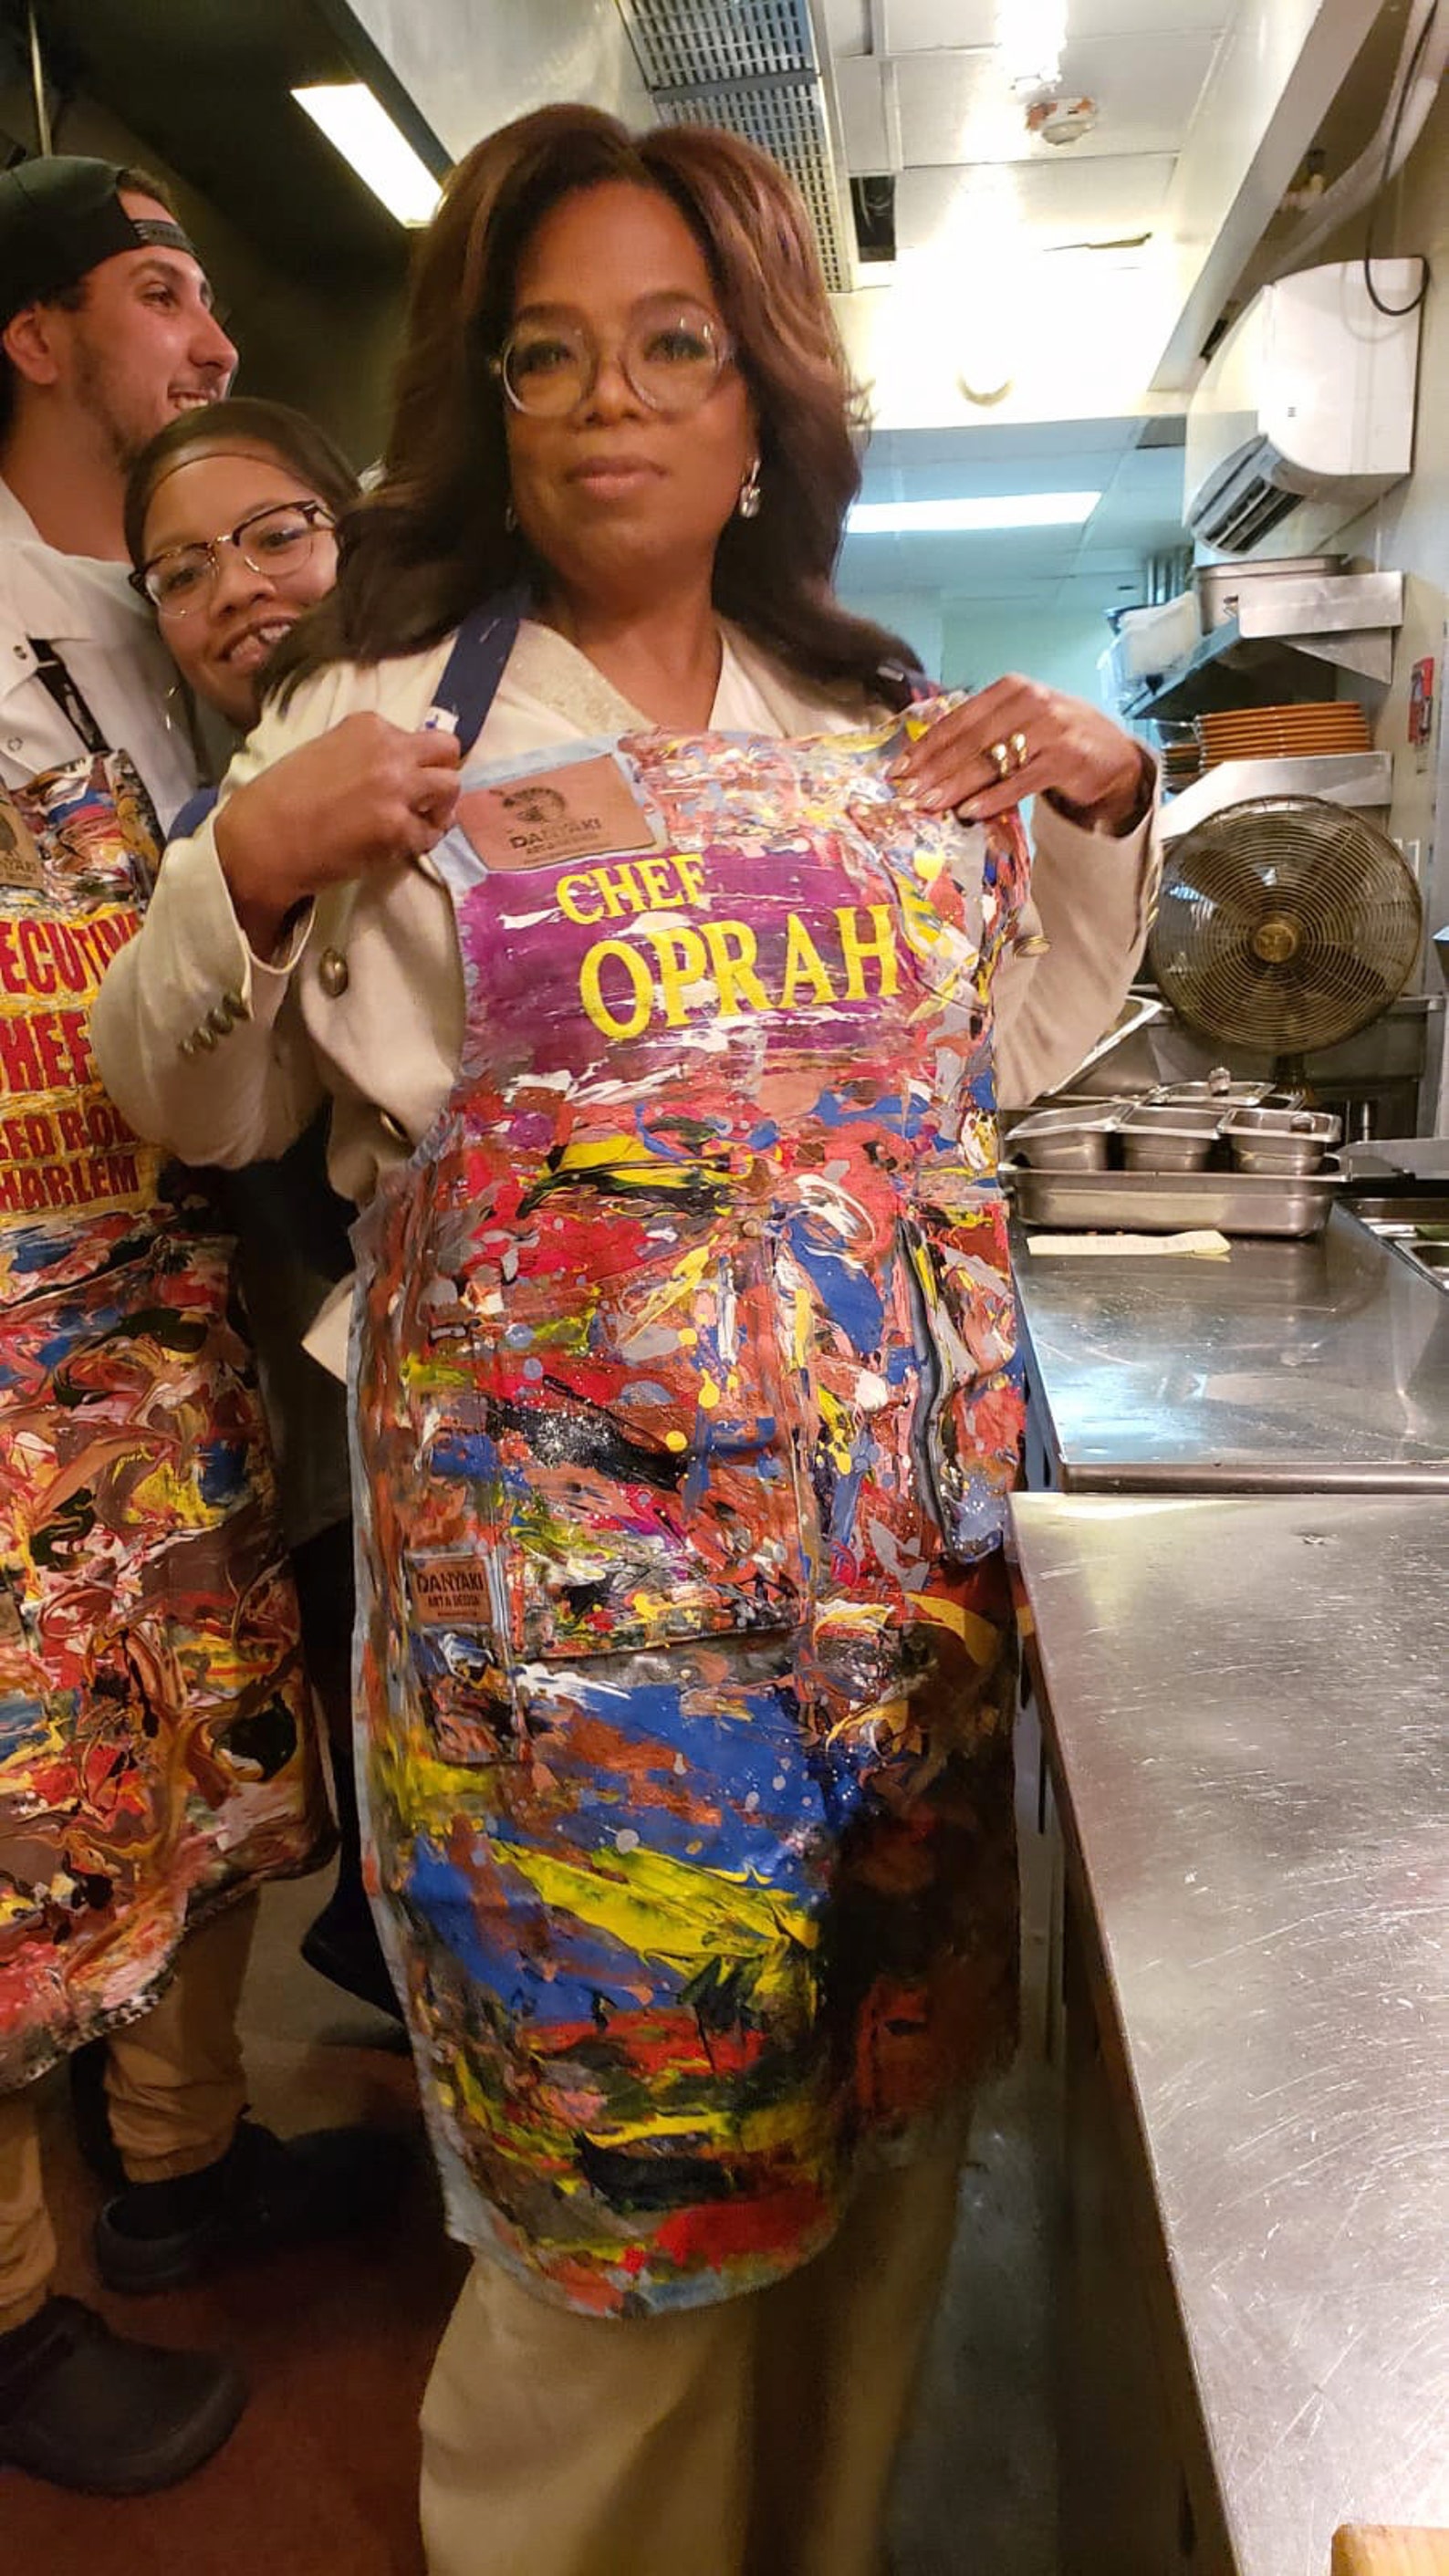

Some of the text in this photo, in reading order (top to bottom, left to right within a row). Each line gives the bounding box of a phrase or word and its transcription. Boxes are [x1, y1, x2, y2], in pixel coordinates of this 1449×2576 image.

[557, 853, 705, 925] CHEF
[579, 903, 902, 1040] OPRAH
[0, 1011, 92, 1092] HEF
[0, 1153, 140, 1212] HARLEM
[416, 1572, 485, 1593] DANYAKI
